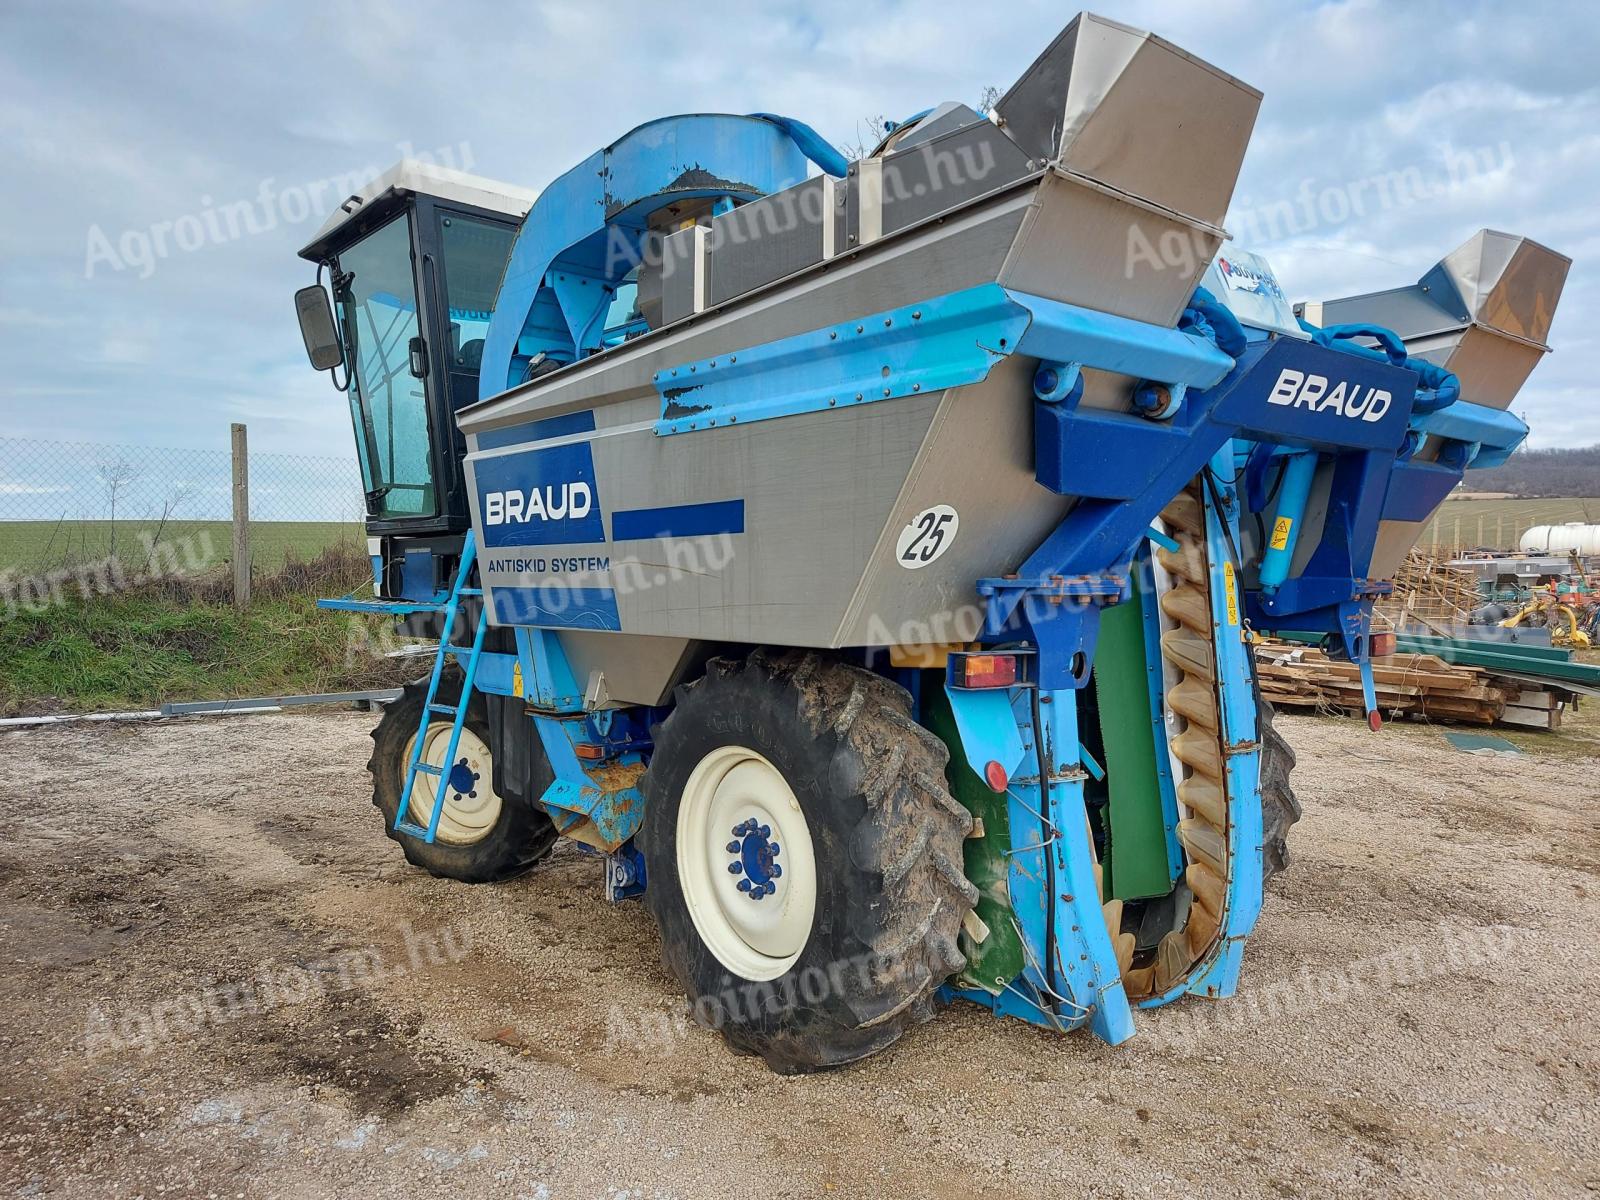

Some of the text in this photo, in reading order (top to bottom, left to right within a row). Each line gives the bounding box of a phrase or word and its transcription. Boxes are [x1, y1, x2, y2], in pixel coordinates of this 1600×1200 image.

[1268, 368, 1392, 422] BRAUD
[485, 482, 592, 526] BRAUD
[901, 512, 954, 562] 25
[488, 557, 610, 573] ANTISKID SYSTEM
